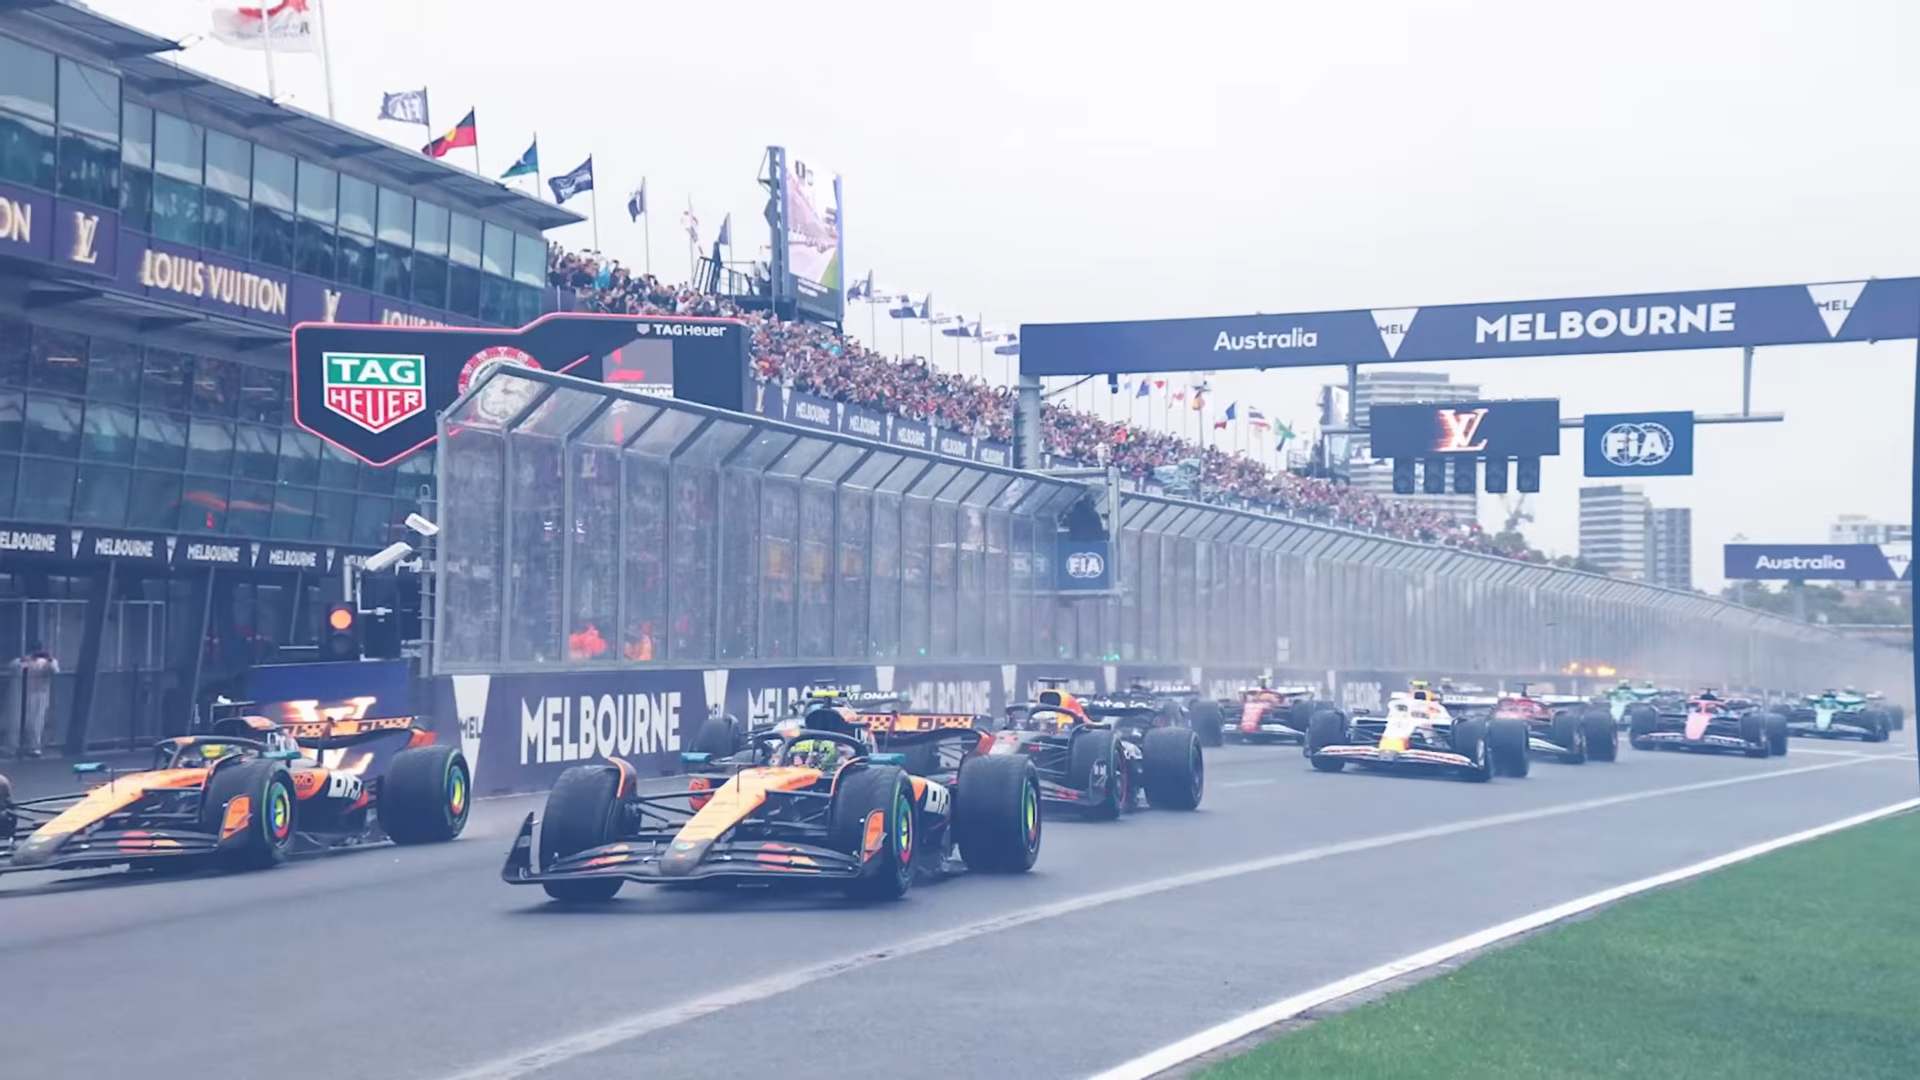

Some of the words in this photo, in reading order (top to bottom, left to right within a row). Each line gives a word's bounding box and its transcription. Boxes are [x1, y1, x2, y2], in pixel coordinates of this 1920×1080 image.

[143, 249, 204, 297] LOUIS
[208, 265, 287, 315] VUITTON
[1378, 324, 1407, 335] MEL
[1475, 302, 1736, 343] MELBOURNE
[1213, 327, 1318, 351] Australia
[331, 358, 416, 384] TAG
[330, 388, 420, 427] HEUER
[0, 531, 56, 552] ELBOURNE
[95, 538, 154, 557] MELBOURNE
[187, 544, 240, 562] MELBOURNE
[269, 550, 317, 567] MELBOURNE
[1755, 555, 1845, 570] Australia
[459, 716, 483, 740] MEL
[521, 692, 681, 765] MELBOURNE
